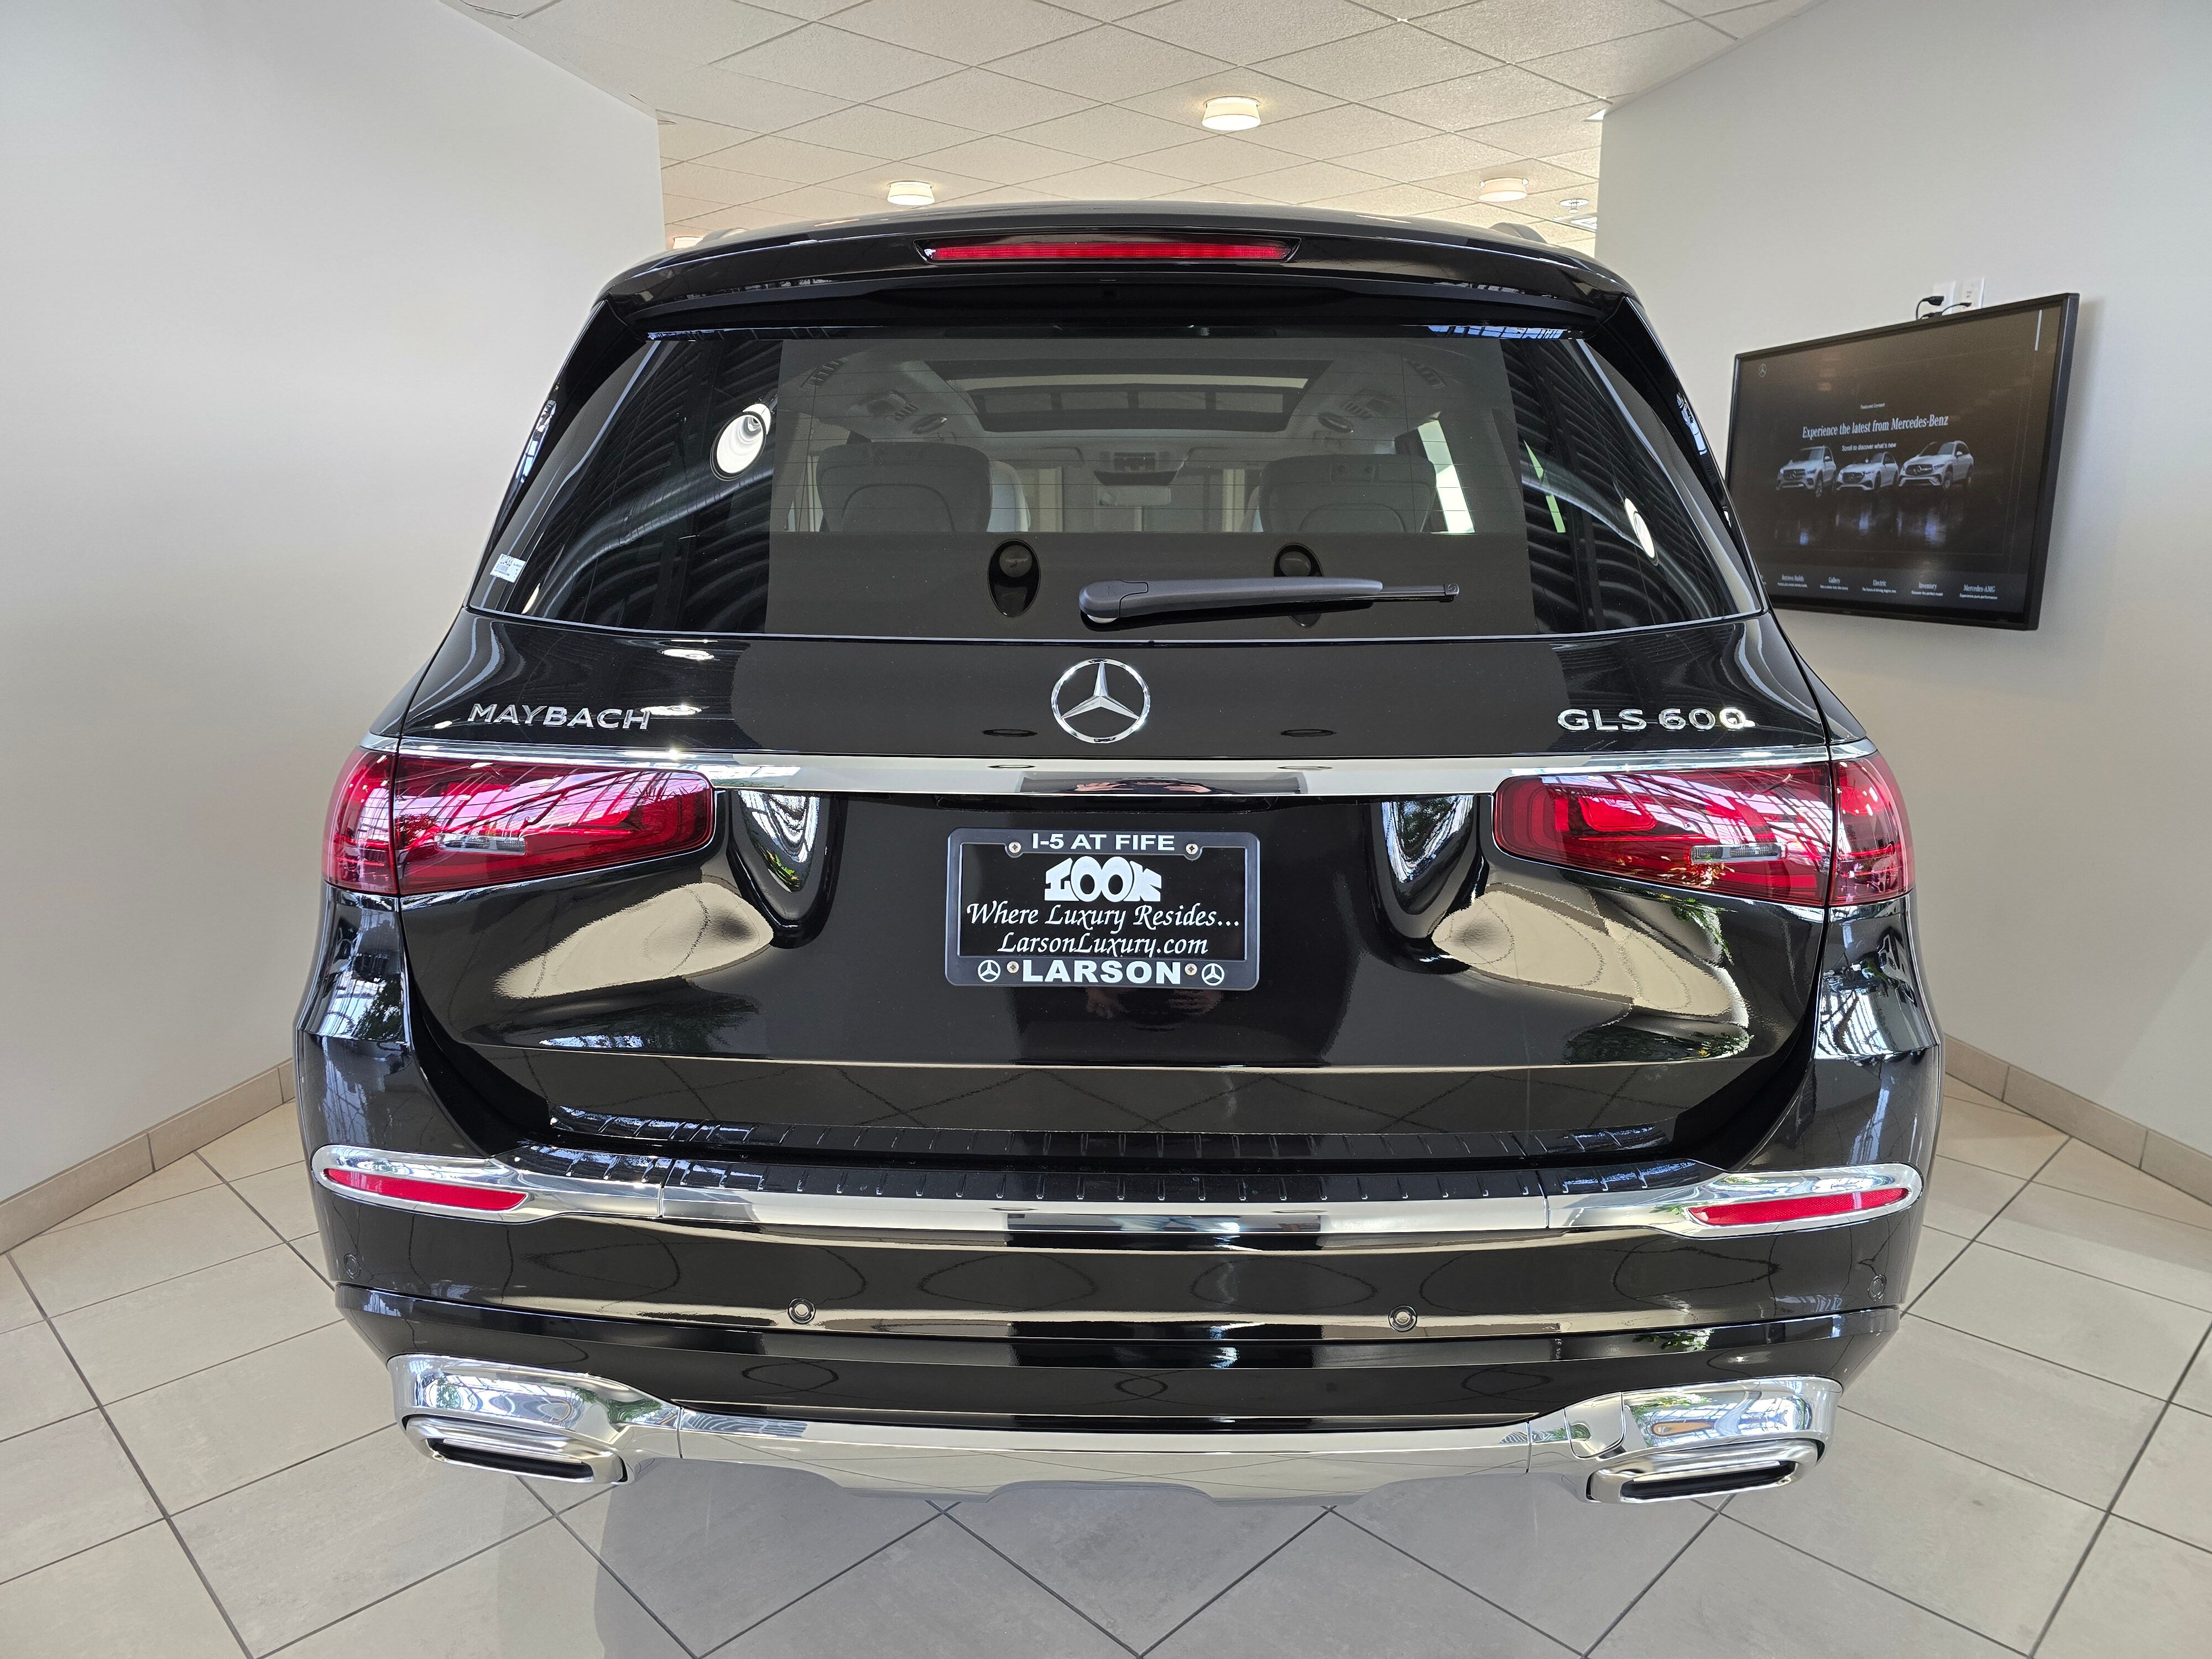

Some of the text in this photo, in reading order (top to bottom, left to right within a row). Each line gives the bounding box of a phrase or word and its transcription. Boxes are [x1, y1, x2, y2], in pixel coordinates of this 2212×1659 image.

[1802, 414, 1949, 440] Experience the latest from Mercedes-Benz
[1964, 584, 1996, 593] Mercedes-AMG
[467, 703, 651, 729] MAYBACH
[1558, 707, 1746, 731] GLS 600
[1032, 833, 1175, 851] I-5 AT FIFE
[967, 900, 1240, 934] Where Luxury Resides...
[997, 931, 1208, 958] LarsonLuxury.com
[1022, 959, 1181, 984] LARSON
